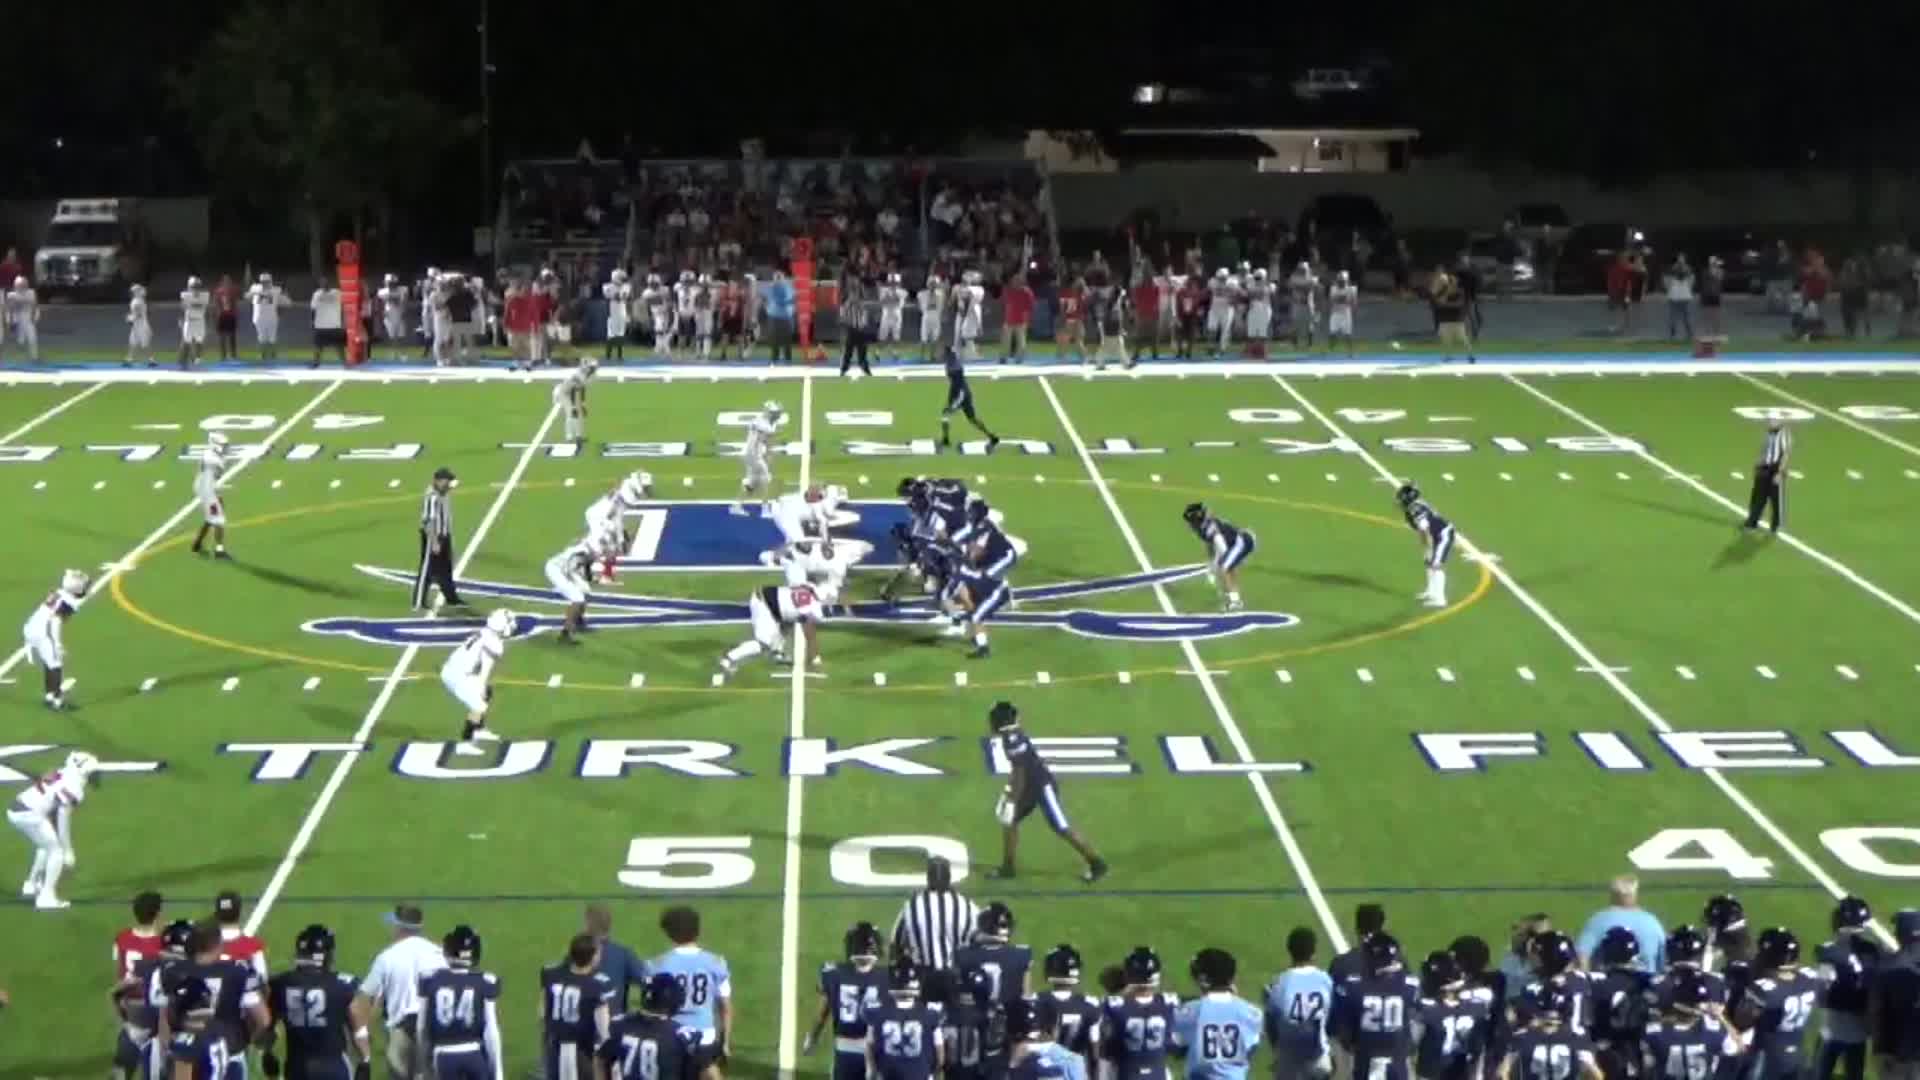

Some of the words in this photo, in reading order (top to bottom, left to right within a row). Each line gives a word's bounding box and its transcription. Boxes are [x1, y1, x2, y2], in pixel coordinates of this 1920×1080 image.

[617, 834, 971, 889] 50
[286, 986, 328, 1028] 52
[435, 987, 476, 1028] 84
[551, 983, 581, 1023] 10
[1290, 990, 1325, 1024] 42
[1361, 995, 1404, 1032] 20
[881, 1019, 922, 1057] 23
[1203, 1023, 1240, 1059] 63
